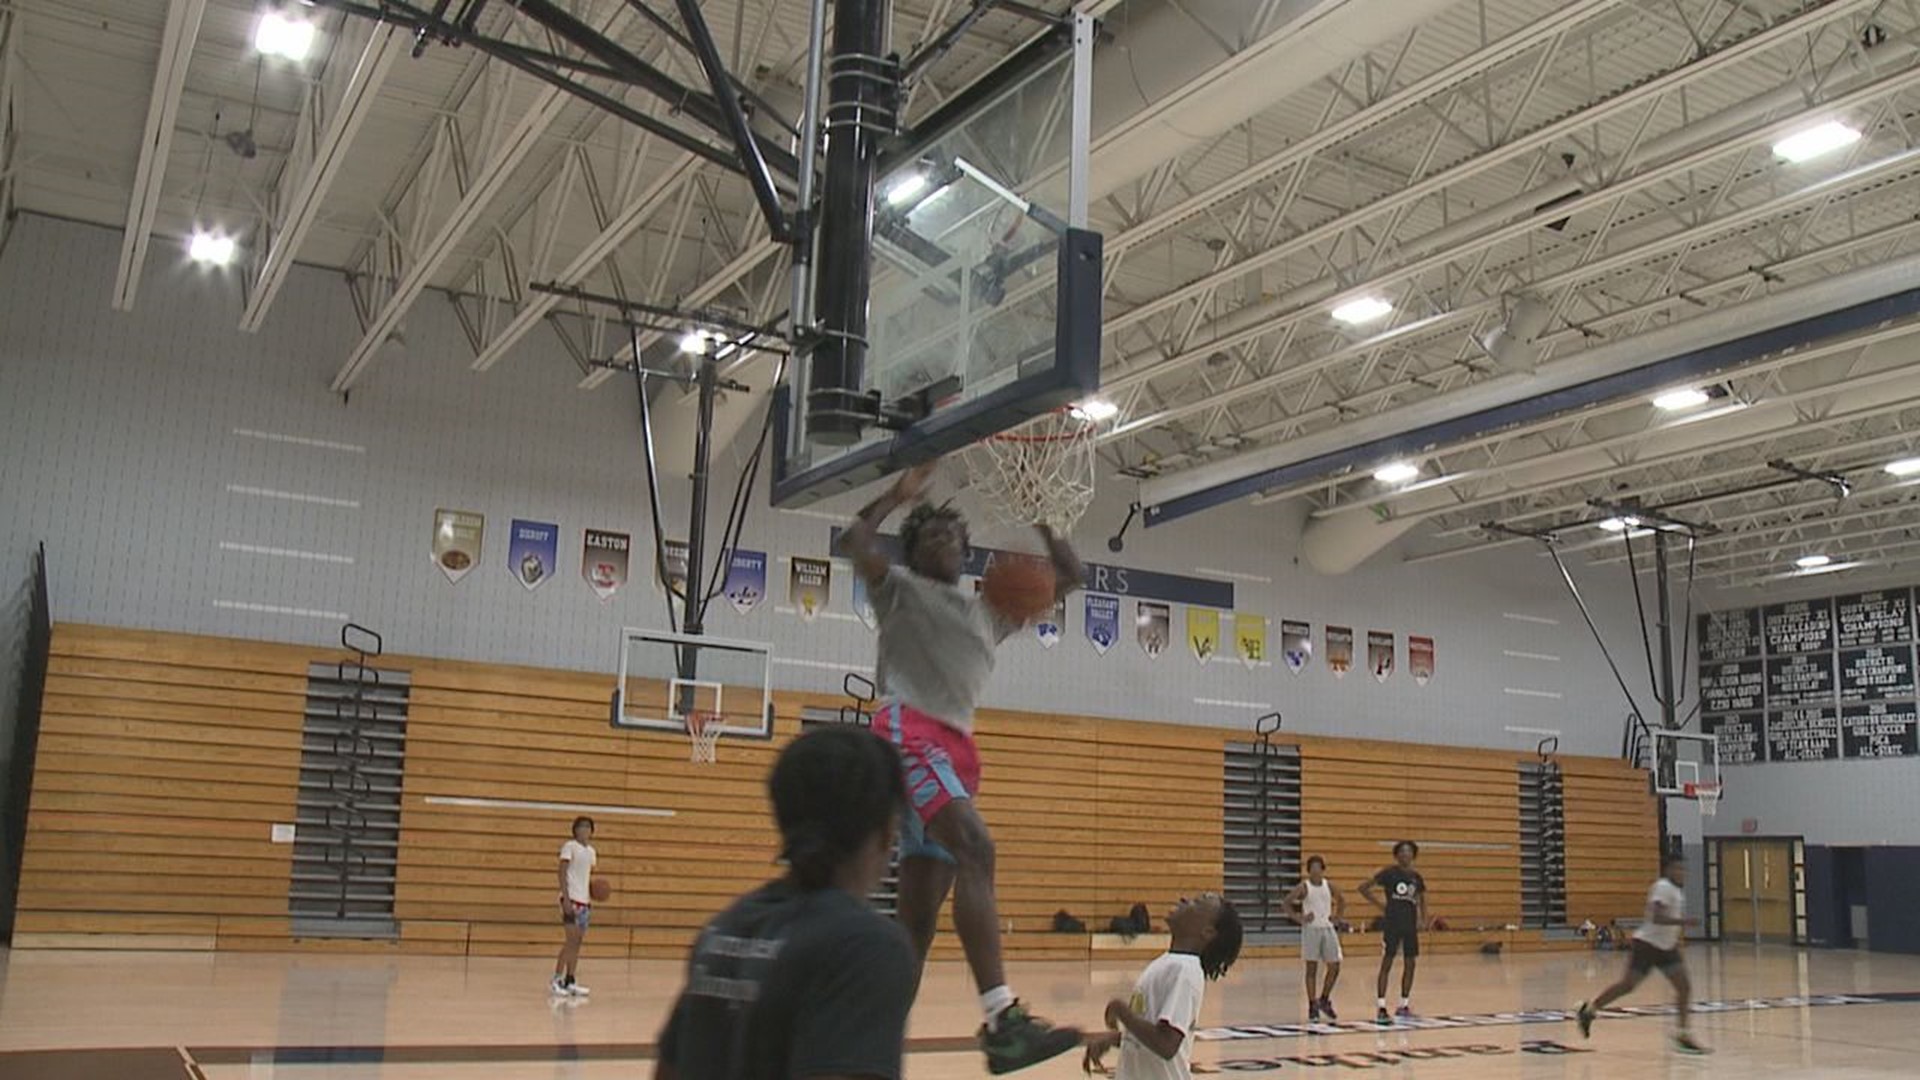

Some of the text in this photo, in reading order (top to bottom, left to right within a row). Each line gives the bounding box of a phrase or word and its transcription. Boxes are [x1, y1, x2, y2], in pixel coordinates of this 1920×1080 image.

[587, 535, 628, 550] EASTON
[1869, 608, 1906, 620] RELAY
[1843, 617, 1905, 632] CHAMPIONS
[1770, 630, 1827, 646] CHAMPIONS
